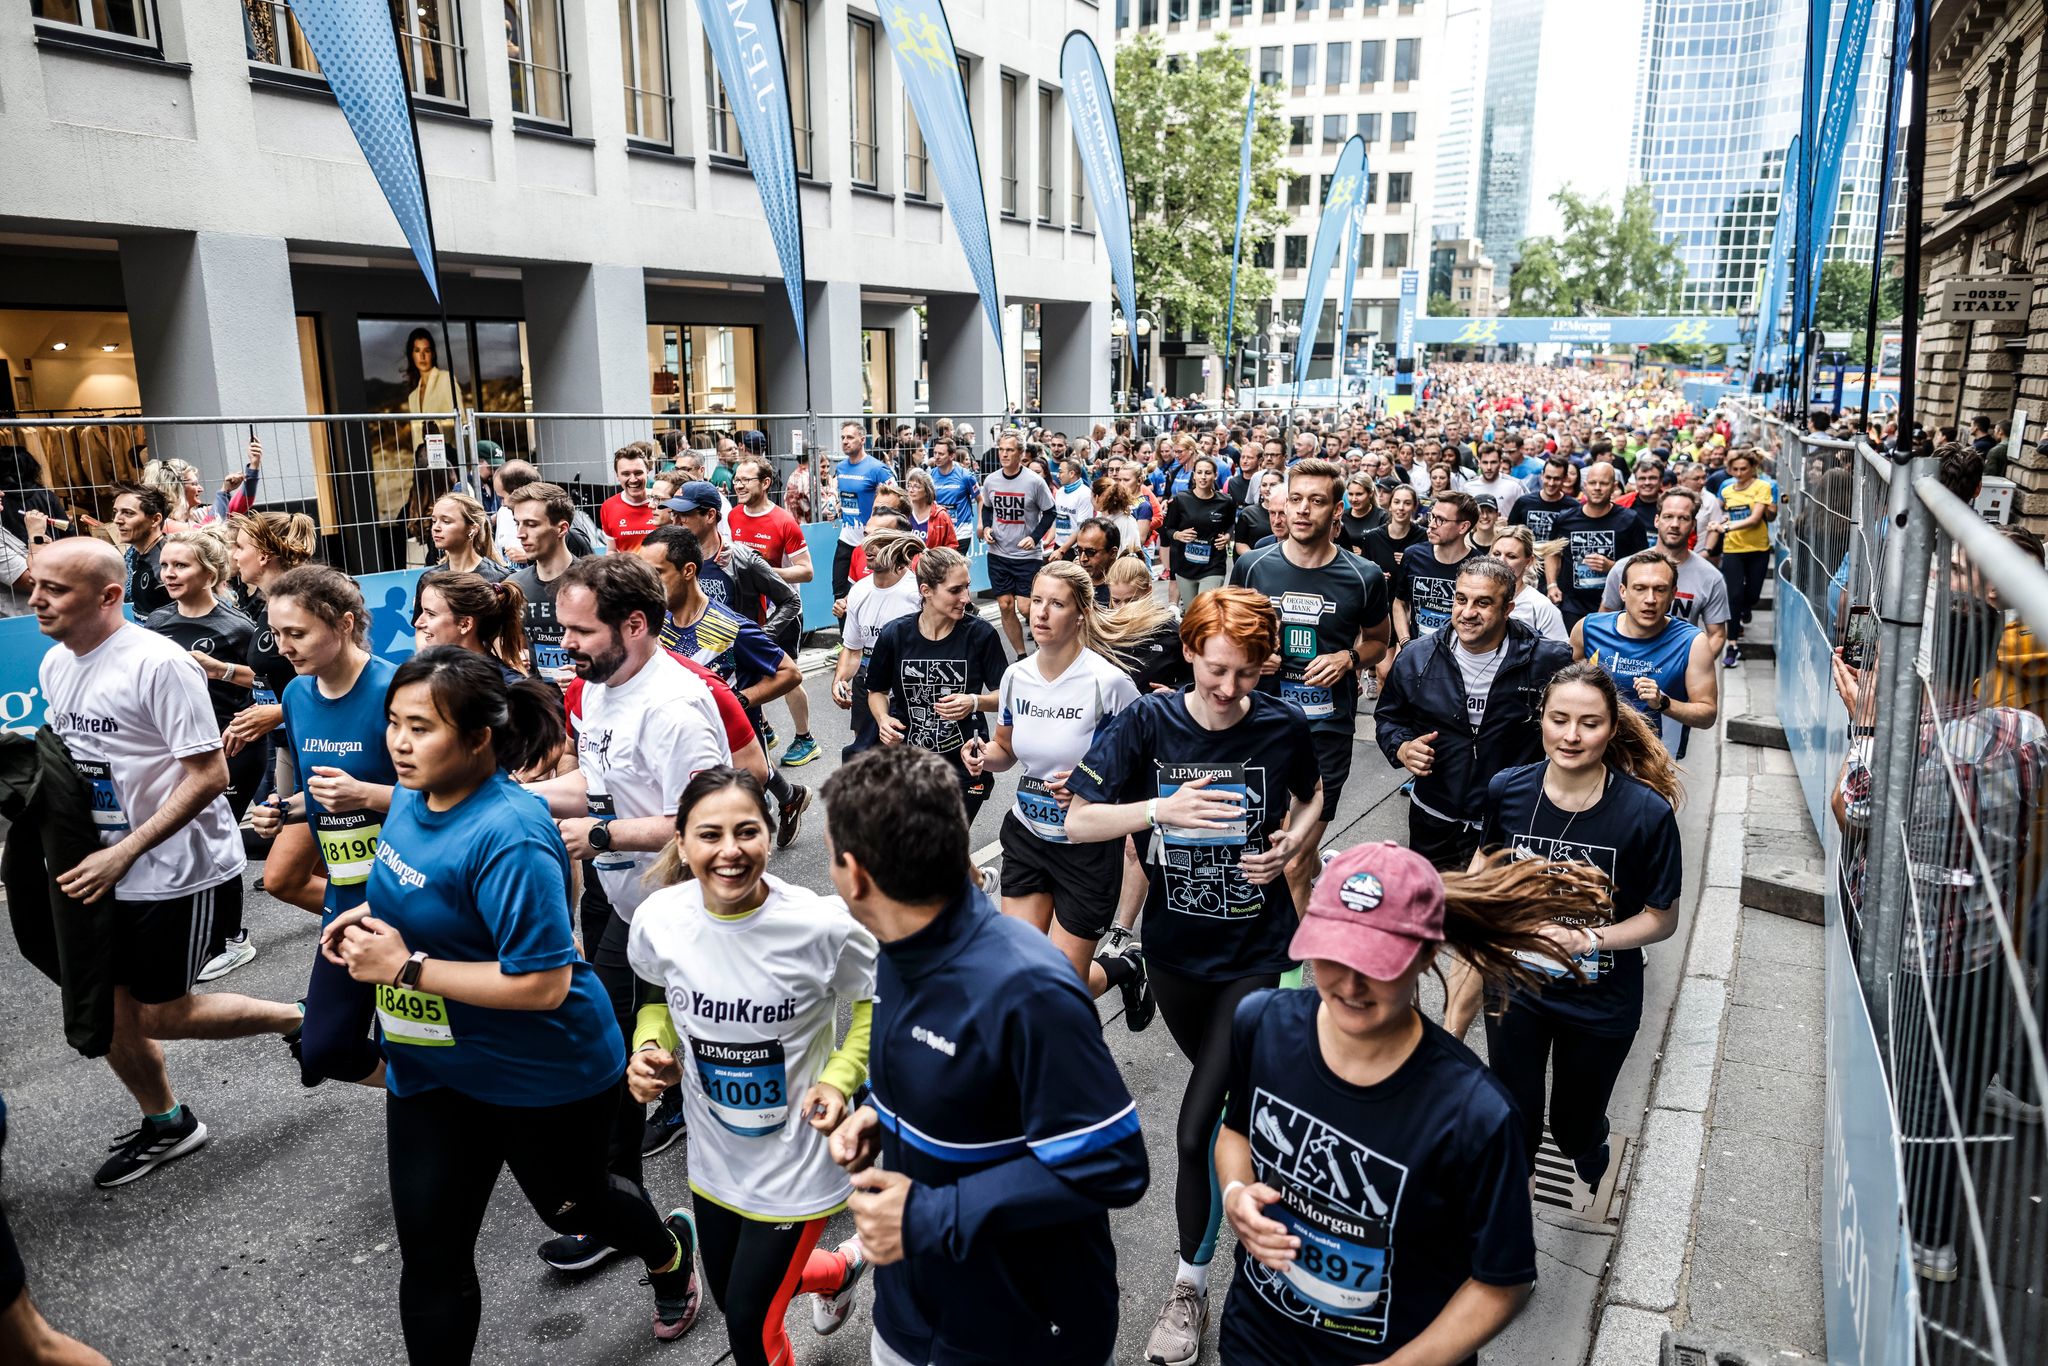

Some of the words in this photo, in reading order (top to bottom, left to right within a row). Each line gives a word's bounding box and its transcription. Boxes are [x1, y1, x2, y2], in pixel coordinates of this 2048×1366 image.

[1969, 289, 2006, 299] 0039
[1952, 301, 2020, 313] ITALY
[1550, 320, 1610, 334] J.P.Morgan
[994, 496, 1024, 509] RUN
[996, 509, 1024, 521] BHP
[1287, 597, 1318, 607] DEGUSSA
[1292, 604, 1311, 612] BANK
[1290, 630, 1311, 645] OLB
[538, 653, 570, 666] 4719
[1620, 657, 1654, 668] DEUTSCHE
[1618, 664, 1663, 675] BUNDESBANK
[302, 738, 363, 756] J.P.Morgan
[1170, 768, 1231, 783] J.P.Morgan
[320, 815, 366, 828] J.P.Morgan
[323, 837, 377, 861] 18190
[375, 840, 427, 888] J.P.Morgan
[1230, 902, 1261, 914] Bloomberg
[378, 984, 442, 1022] 18495
[698, 1044, 770, 1064] J.P.Morgan
[729, 1070, 754, 1078] Frankfurt
[1280, 1186, 1365, 1238] J.P.Morgan
[1324, 1319, 1376, 1337] Bloomberg
